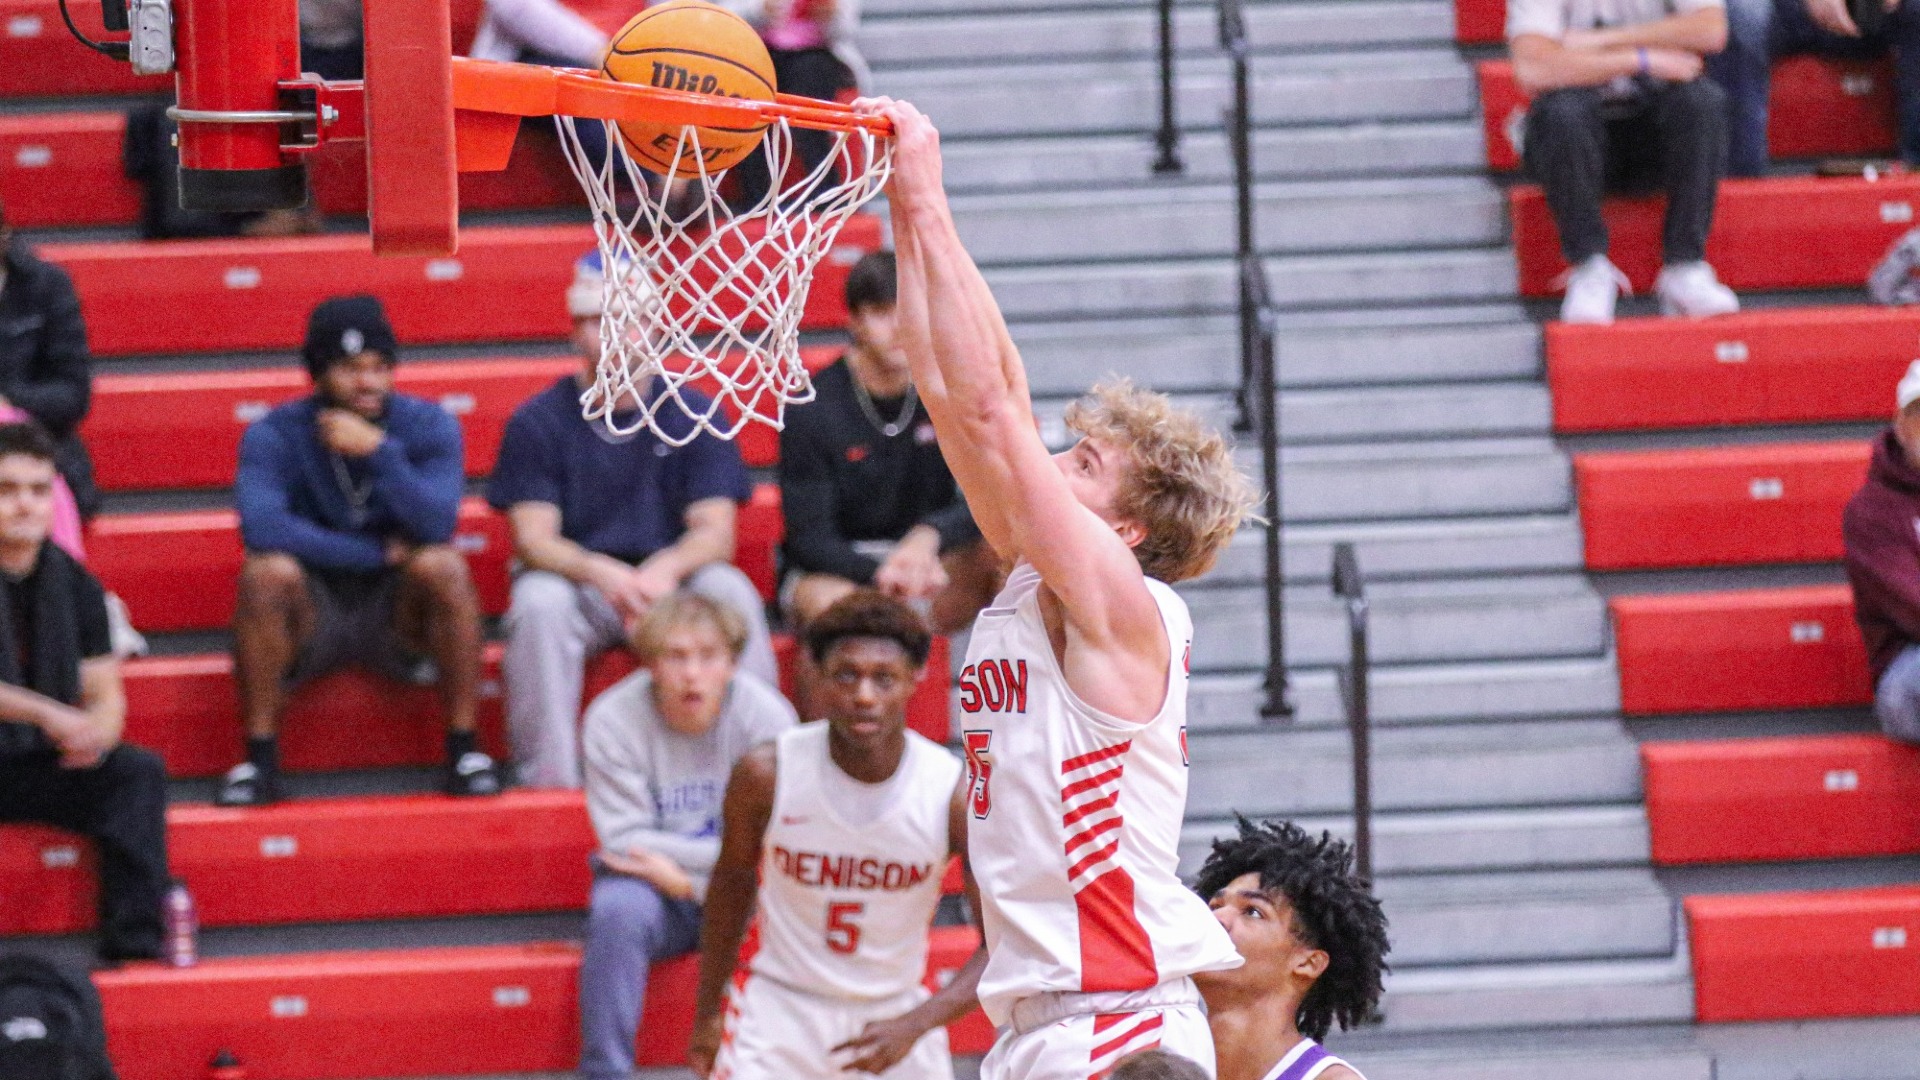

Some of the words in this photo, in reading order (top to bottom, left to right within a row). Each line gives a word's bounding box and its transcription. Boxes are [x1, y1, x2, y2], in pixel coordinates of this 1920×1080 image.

[652, 61, 750, 100] Wil
[964, 730, 992, 820] 5
[774, 846, 932, 892] DENISON
[826, 901, 864, 955] 5
